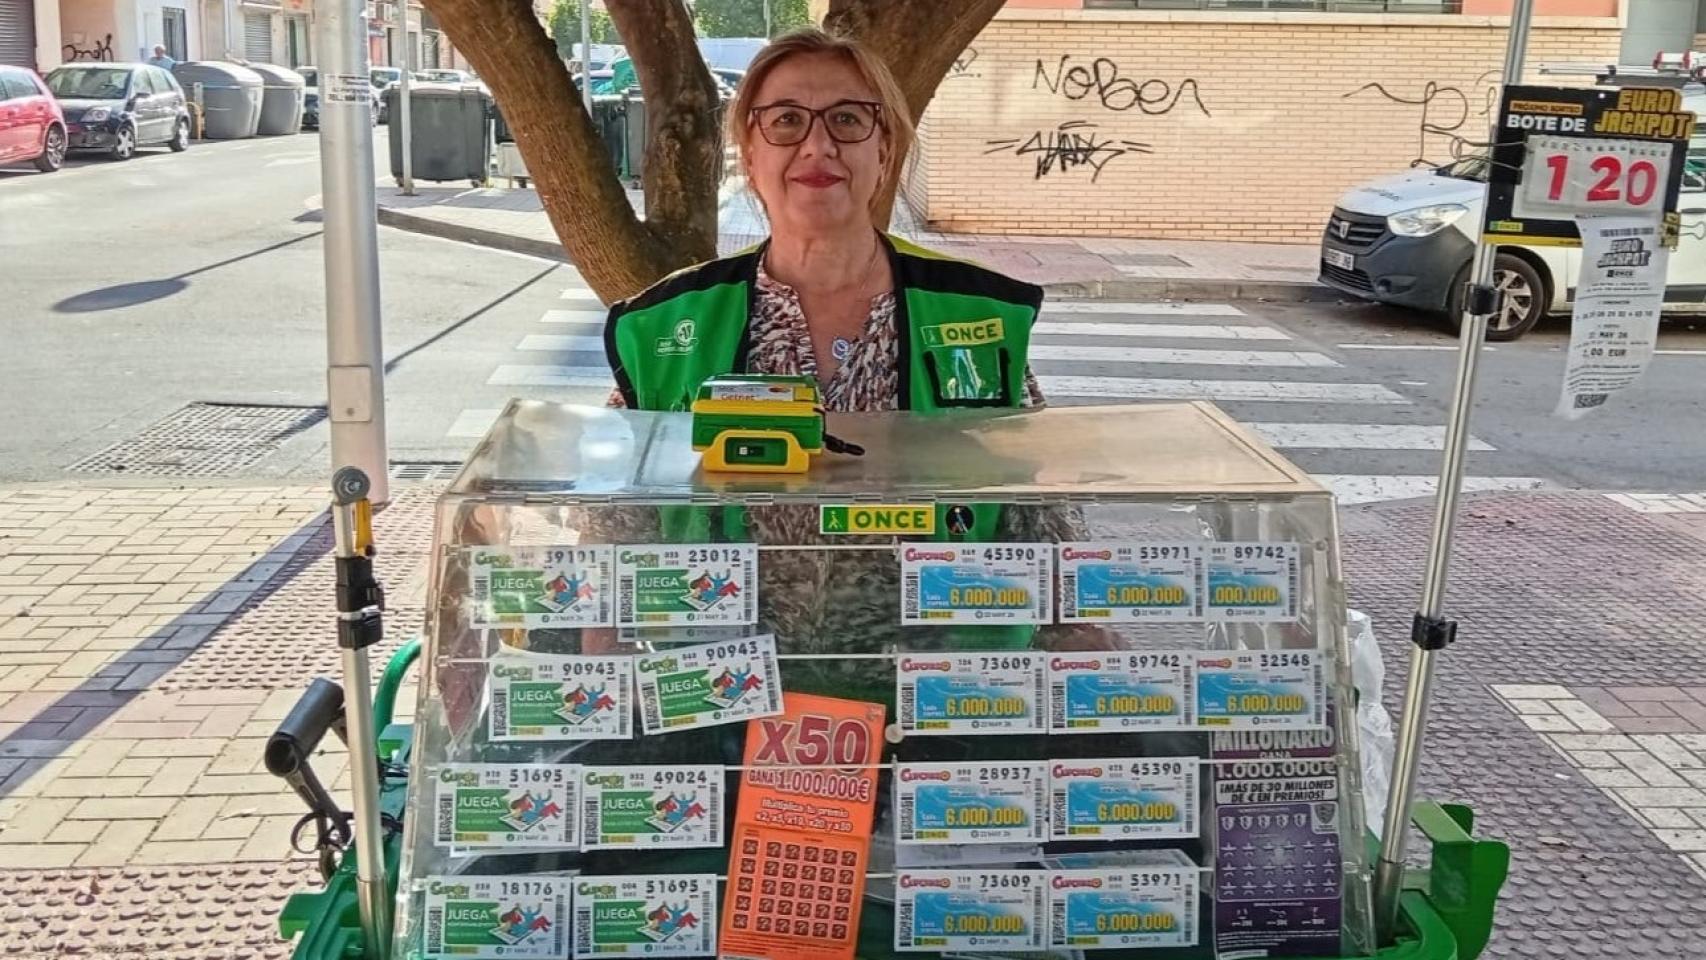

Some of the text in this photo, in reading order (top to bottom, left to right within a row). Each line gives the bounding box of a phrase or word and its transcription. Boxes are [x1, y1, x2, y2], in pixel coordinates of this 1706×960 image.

[1618, 88, 1677, 112] EURO
[1506, 114, 1587, 132] BOTE DE
[1593, 110, 1690, 139] JACKPOT
[946, 322, 997, 342] ONCE
[854, 510, 927, 529] ONCE
[688, 549, 741, 563] 23012
[983, 547, 1035, 561] 45390
[1140, 546, 1189, 560] 53971
[1234, 546, 1285, 559] 89742
[493, 578, 535, 589] JUEGA
[638, 576, 680, 588] JUEGA
[706, 640, 759, 660] 90943
[980, 656, 1032, 671] 73609
[1129, 654, 1181, 669] 89742
[1260, 653, 1310, 667] 32548
[562, 662, 616, 676] 90943
[660, 678, 703, 694] JUEGA
[512, 690, 554, 701] JUEGA
[1214, 726, 1335, 751] MILLONARIO
[509, 768, 563, 783] 51695
[979, 767, 1031, 781] 28937
[1130, 762, 1181, 776] 45390
[653, 770, 707, 784] 49024
[748, 769, 870, 801] GANA 1.000.000€
[1250, 782, 1264, 793] DE
[1284, 779, 1335, 791] MILLONES
[458, 796, 501, 808] JUEGA
[1273, 790, 1326, 802] PREMIOS!
[603, 798, 646, 810] JUEGA
[645, 879, 699, 894] 51695
[979, 874, 1031, 888] 73609
[1130, 873, 1181, 887] 53971
[501, 882, 553, 896] 18176
[447, 908, 490, 921] JUEGA
[595, 907, 638, 920] JUEGA
